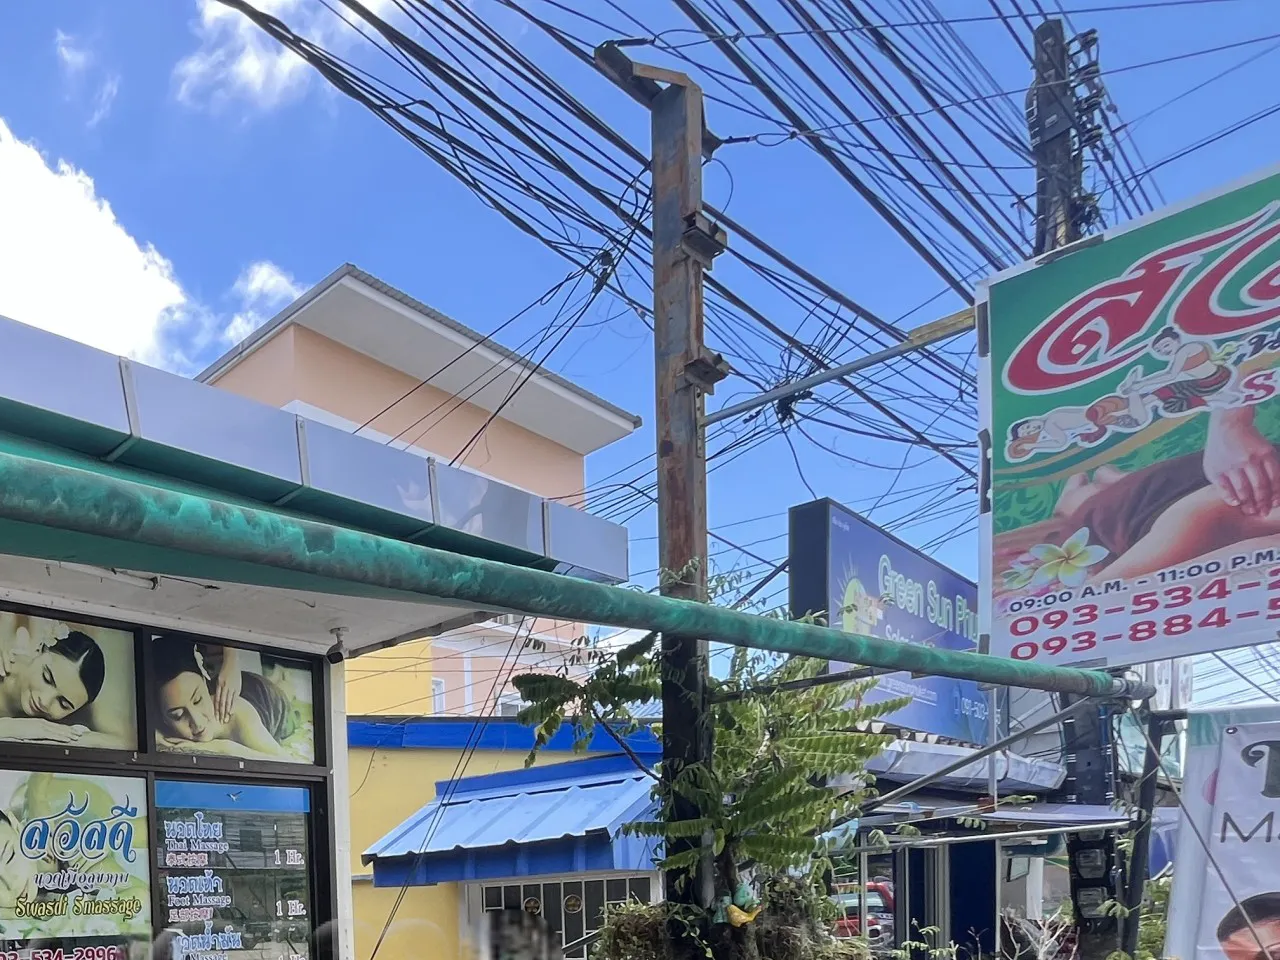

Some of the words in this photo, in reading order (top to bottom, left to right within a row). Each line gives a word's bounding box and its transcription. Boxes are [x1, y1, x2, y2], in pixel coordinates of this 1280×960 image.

[878, 554, 924, 618] Green
[927, 579, 953, 632] Sun
[1010, 591, 1073, 614] 09:00
[1080, 580, 1128, 599] A.M.
[1156, 560, 1221, 584] 11:00
[20, 790, 138, 863] สวัสดี
[1220, 811, 1280, 843] M
[165, 839, 188, 851] Thai
[190, 840, 229, 853] Massage
[274, 849, 281, 865] 1
[286, 849, 305, 865] Hr.
[166, 870, 223, 893] นวดเท้า
[15, 896, 68, 917] Swasdi
[73, 896, 142, 922] Smassage
[167, 895, 190, 907] Foot
[192, 894, 232, 908] Massage
[276, 900, 283, 916] 1
[287, 900, 307, 916] Hr.
